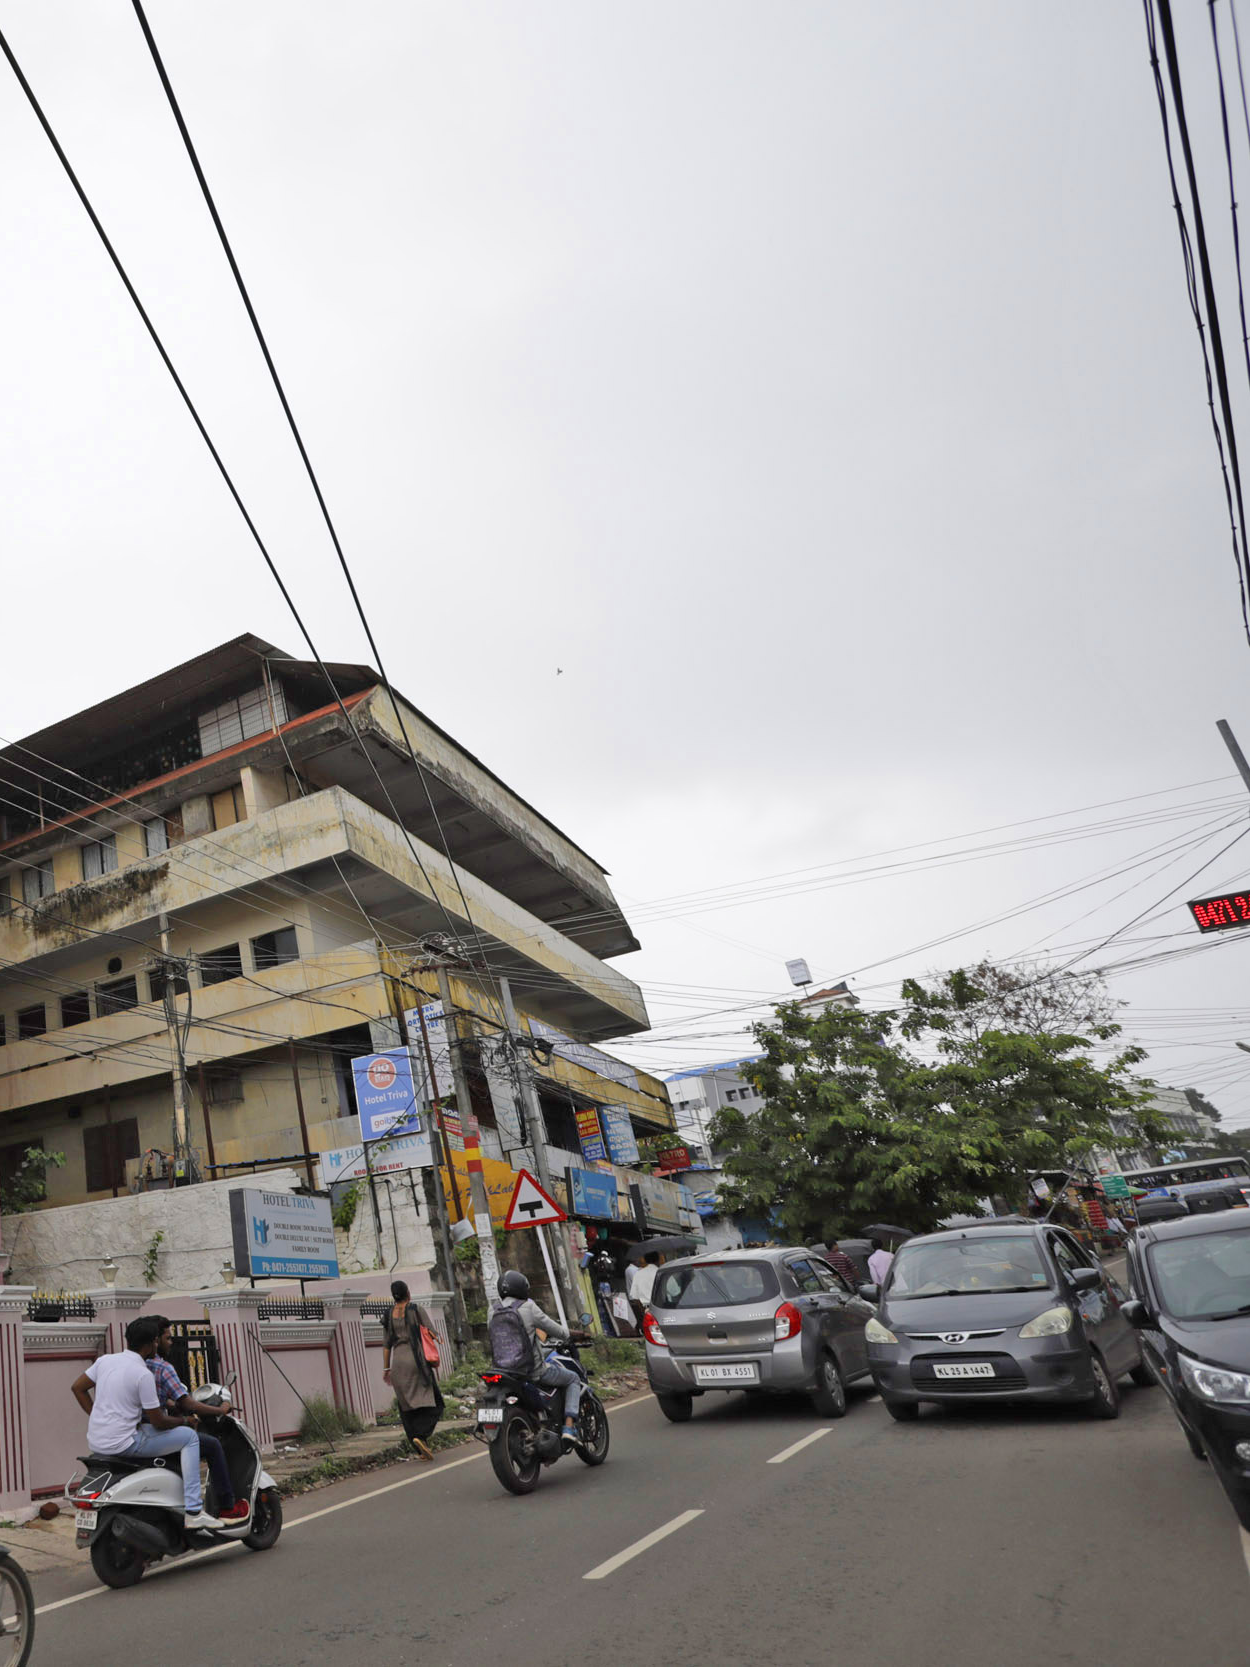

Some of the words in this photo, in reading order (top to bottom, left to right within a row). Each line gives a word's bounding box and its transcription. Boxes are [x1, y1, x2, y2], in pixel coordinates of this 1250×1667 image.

[364, 1094, 387, 1105] Hotel
[388, 1089, 409, 1099] Triva
[389, 1136, 426, 1152] TRIVA
[263, 1193, 291, 1208] HOTEL
[291, 1197, 316, 1210] TRIVA
[700, 1368, 709, 1377] KL
[710, 1368, 718, 1377] 01
[722, 1367, 732, 1376] BX
[734, 1367, 751, 1376] 4551
[937, 1367, 950, 1376] KL
[950, 1367, 961, 1376] 25
[962, 1367, 969, 1375] A
[970, 1366, 989, 1375] 1447
